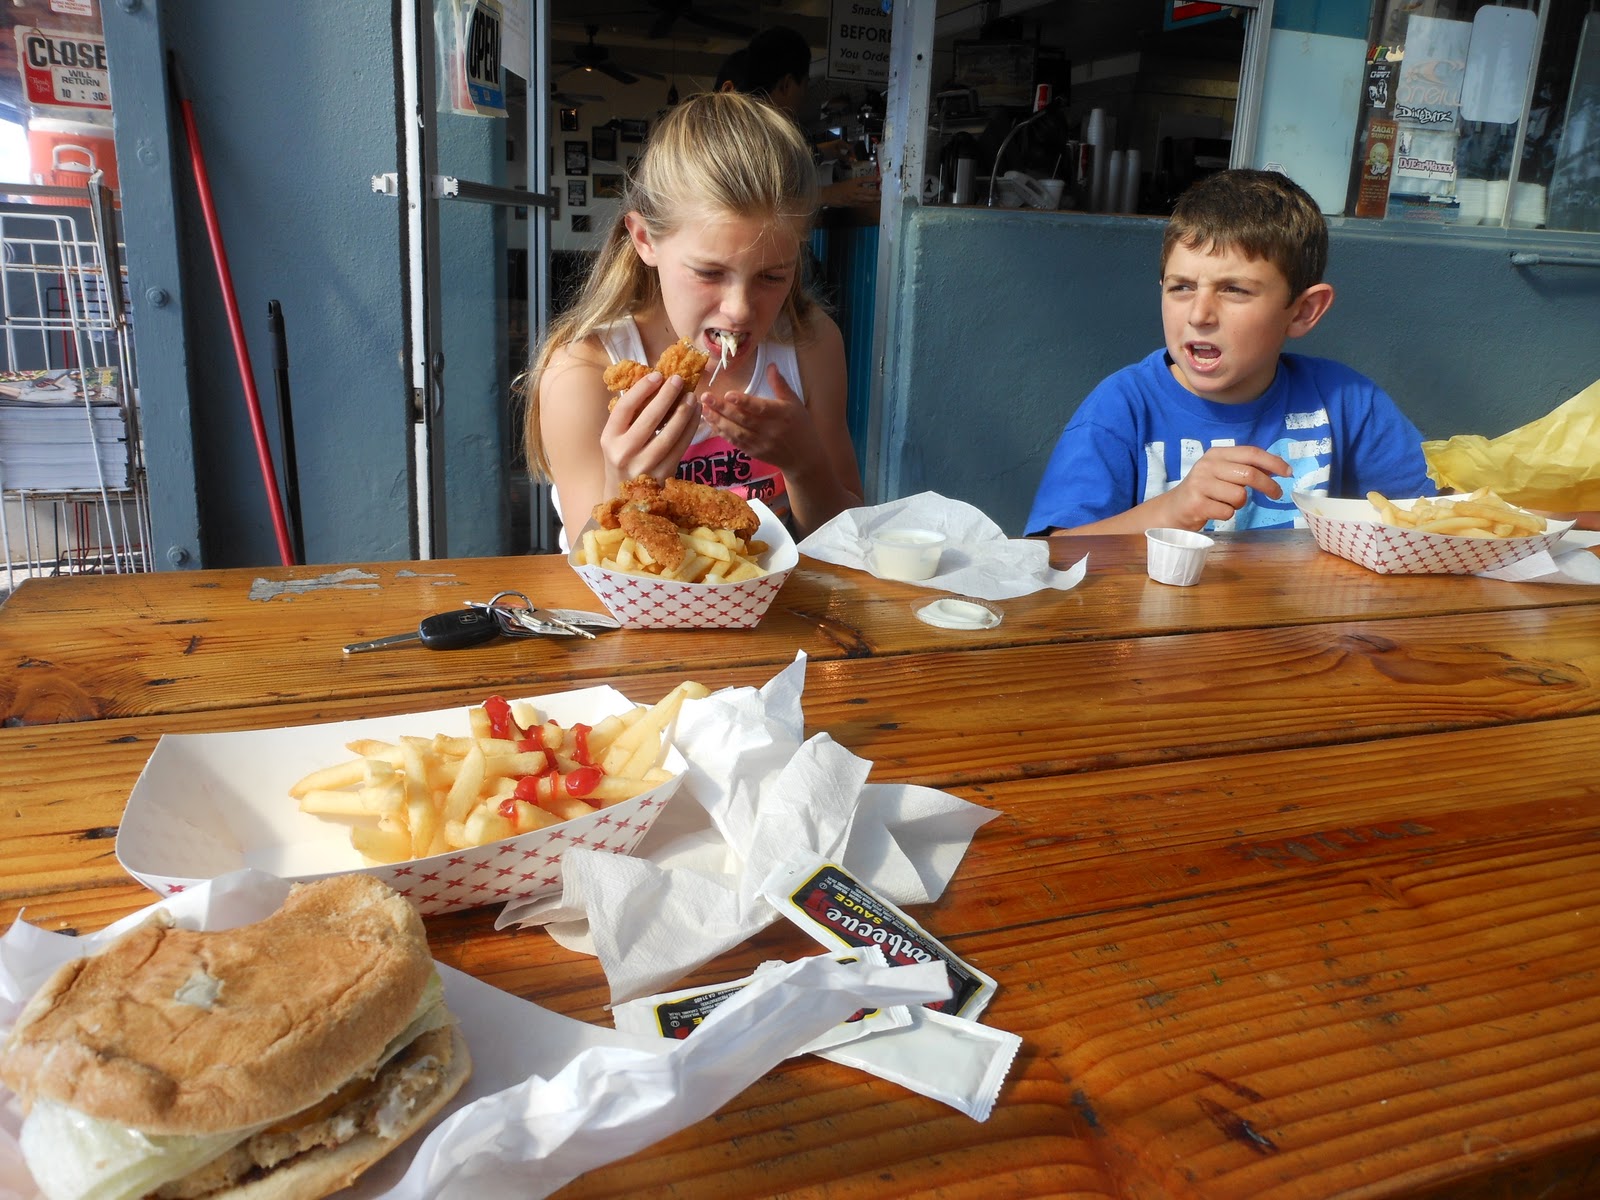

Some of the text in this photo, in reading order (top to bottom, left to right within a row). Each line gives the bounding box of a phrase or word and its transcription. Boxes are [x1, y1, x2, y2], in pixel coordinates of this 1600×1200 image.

[851, 3, 888, 18] Snacks
[27, 37, 107, 70] CLOSE
[469, 7, 499, 85] OPEN
[840, 47, 889, 63] You Orde
[61, 76, 100, 87] RETURN
[68, 69, 92, 79] WILL
[834, 892, 883, 925] SAUCE
[826, 907, 932, 965] arbecue
